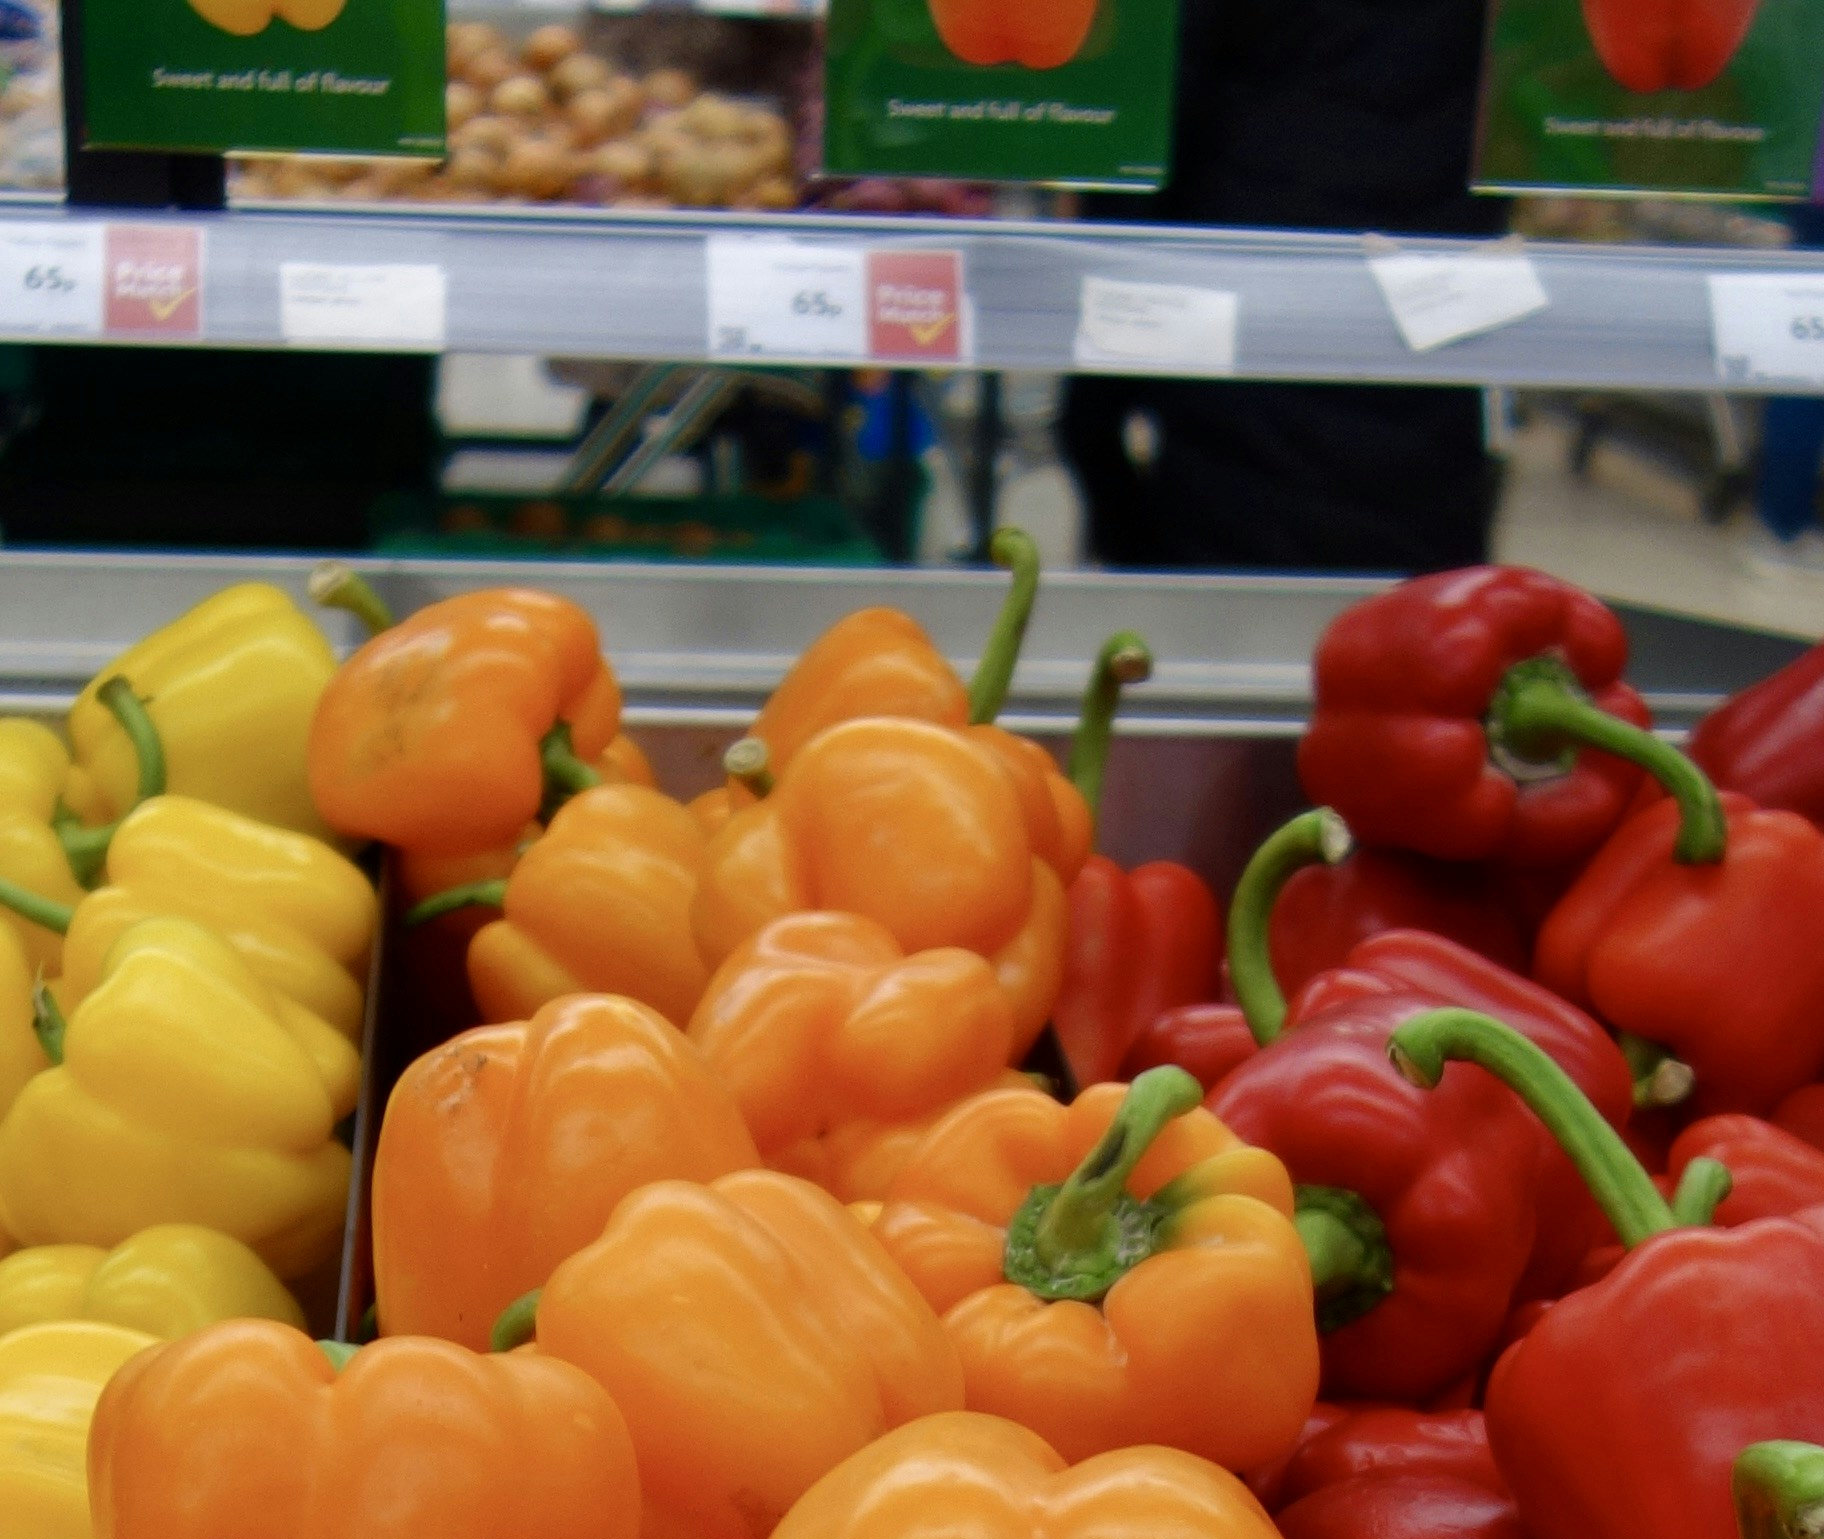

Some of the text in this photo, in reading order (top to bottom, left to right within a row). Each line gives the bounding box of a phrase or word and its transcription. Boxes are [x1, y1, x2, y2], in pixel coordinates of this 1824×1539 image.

[152, 67, 392, 95] Sweet and full of flavour
[887, 99, 1115, 124] Sweet and full of flavour
[24, 265, 76, 293] 65p
[793, 289, 843, 318] 65p
